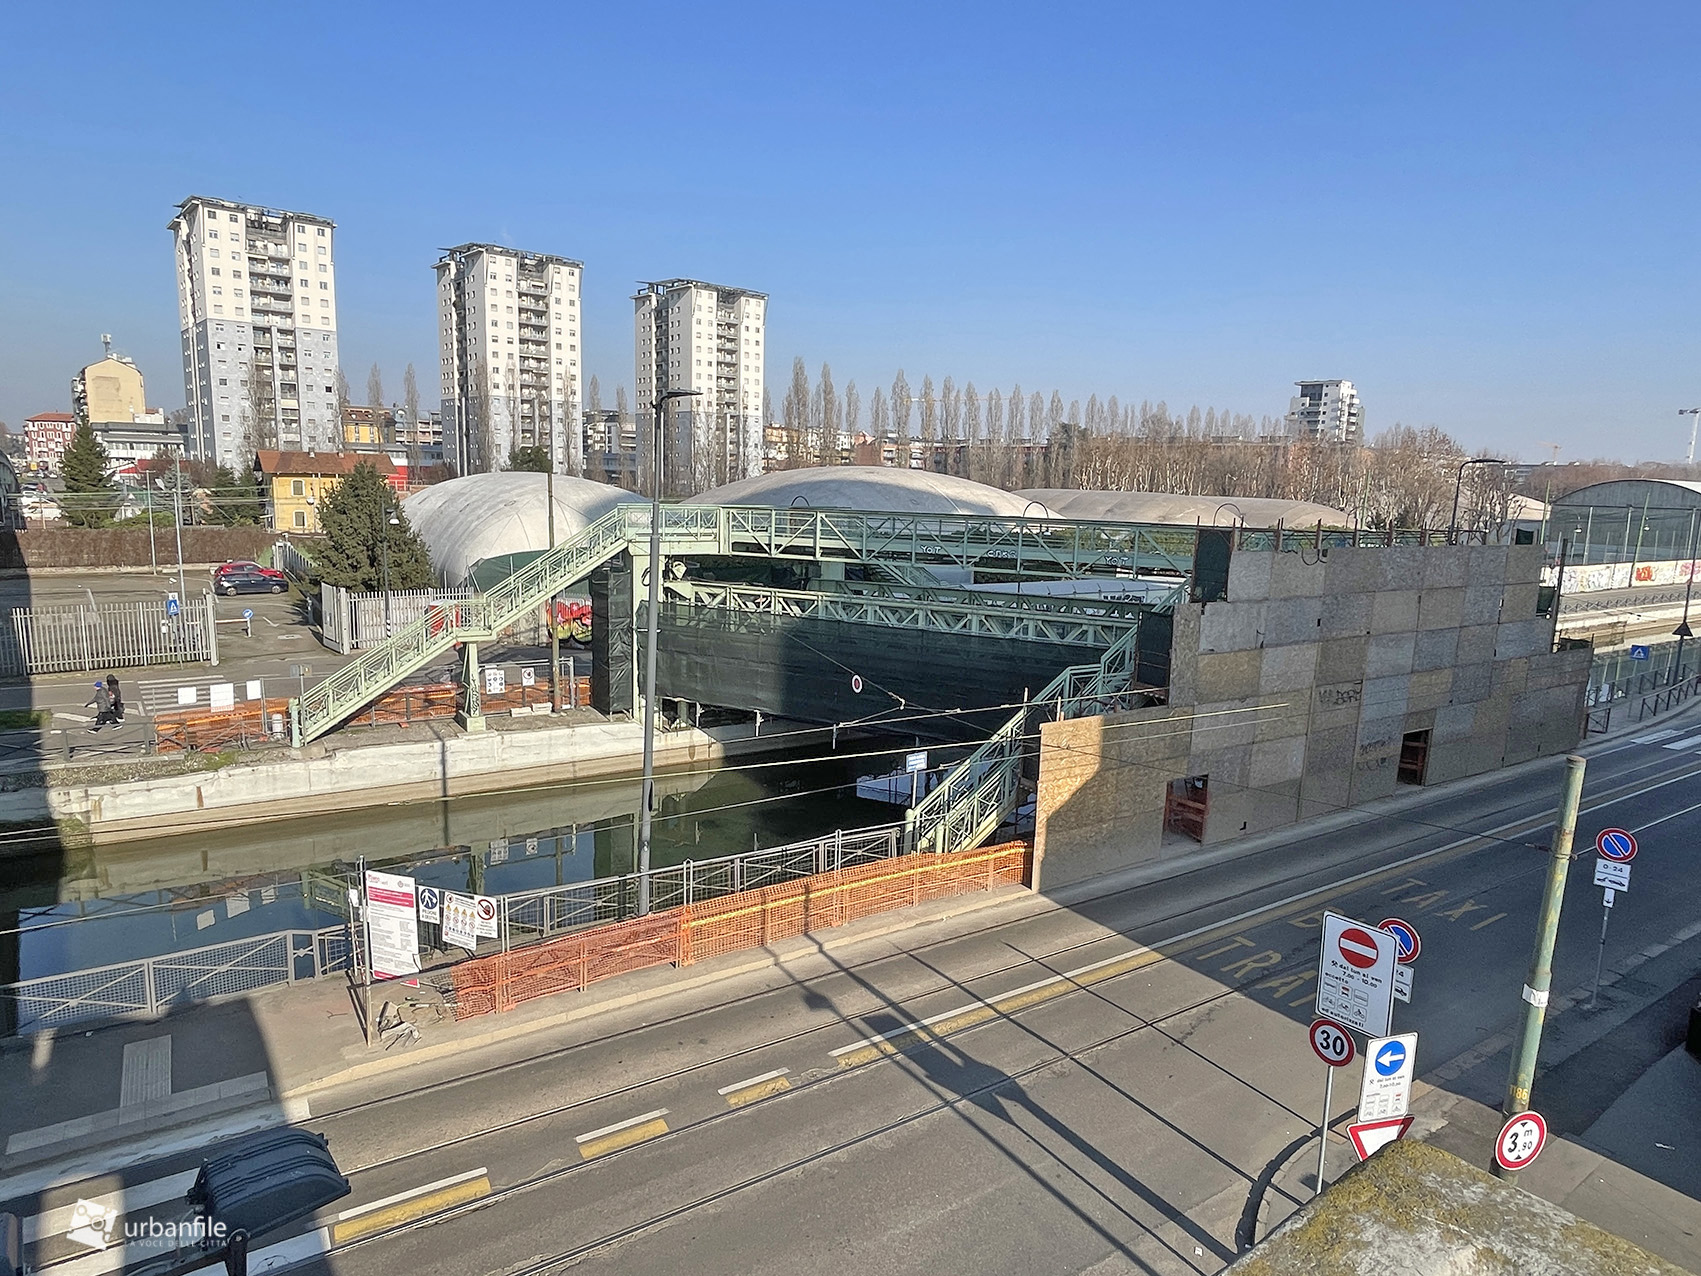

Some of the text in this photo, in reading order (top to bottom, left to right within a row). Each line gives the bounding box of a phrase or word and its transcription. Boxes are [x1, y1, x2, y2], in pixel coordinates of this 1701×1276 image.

[1381, 877, 1508, 931] TAXI
[1196, 936, 1319, 1009] TRA
[1324, 971, 1349, 984] eccetto
[1350, 967, 1361, 975] lun
[1370, 976, 1383, 984] ven
[1330, 1011, 1364, 1028] autorizzati
[1319, 1029, 1345, 1056] 30
[1524, 1129, 1533, 1137] m
